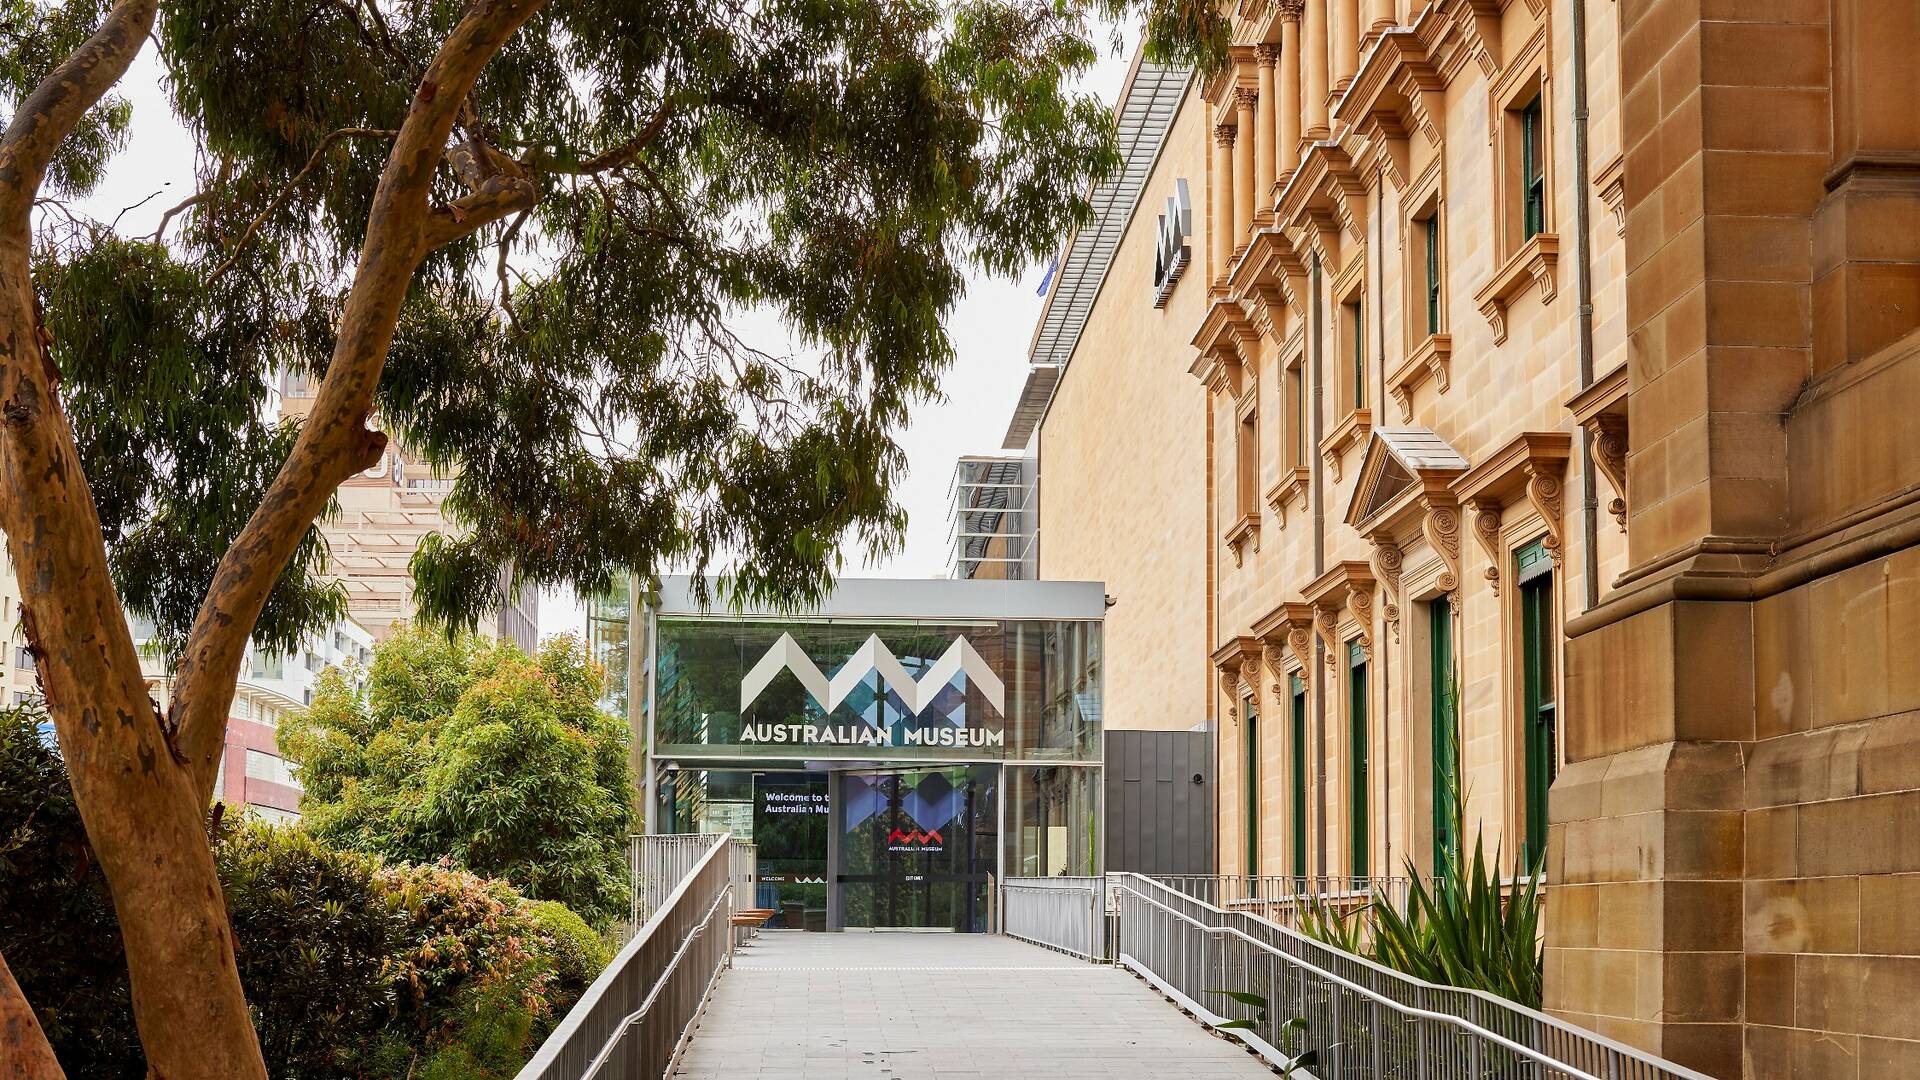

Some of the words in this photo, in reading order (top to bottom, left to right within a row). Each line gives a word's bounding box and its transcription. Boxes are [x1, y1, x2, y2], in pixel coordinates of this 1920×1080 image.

[740, 724, 892, 744] AUSTRALIAN
[904, 728, 1004, 746] MUSEUM
[765, 793, 810, 802] Welcome
[812, 794, 822, 802] to
[765, 804, 813, 813] Australian
